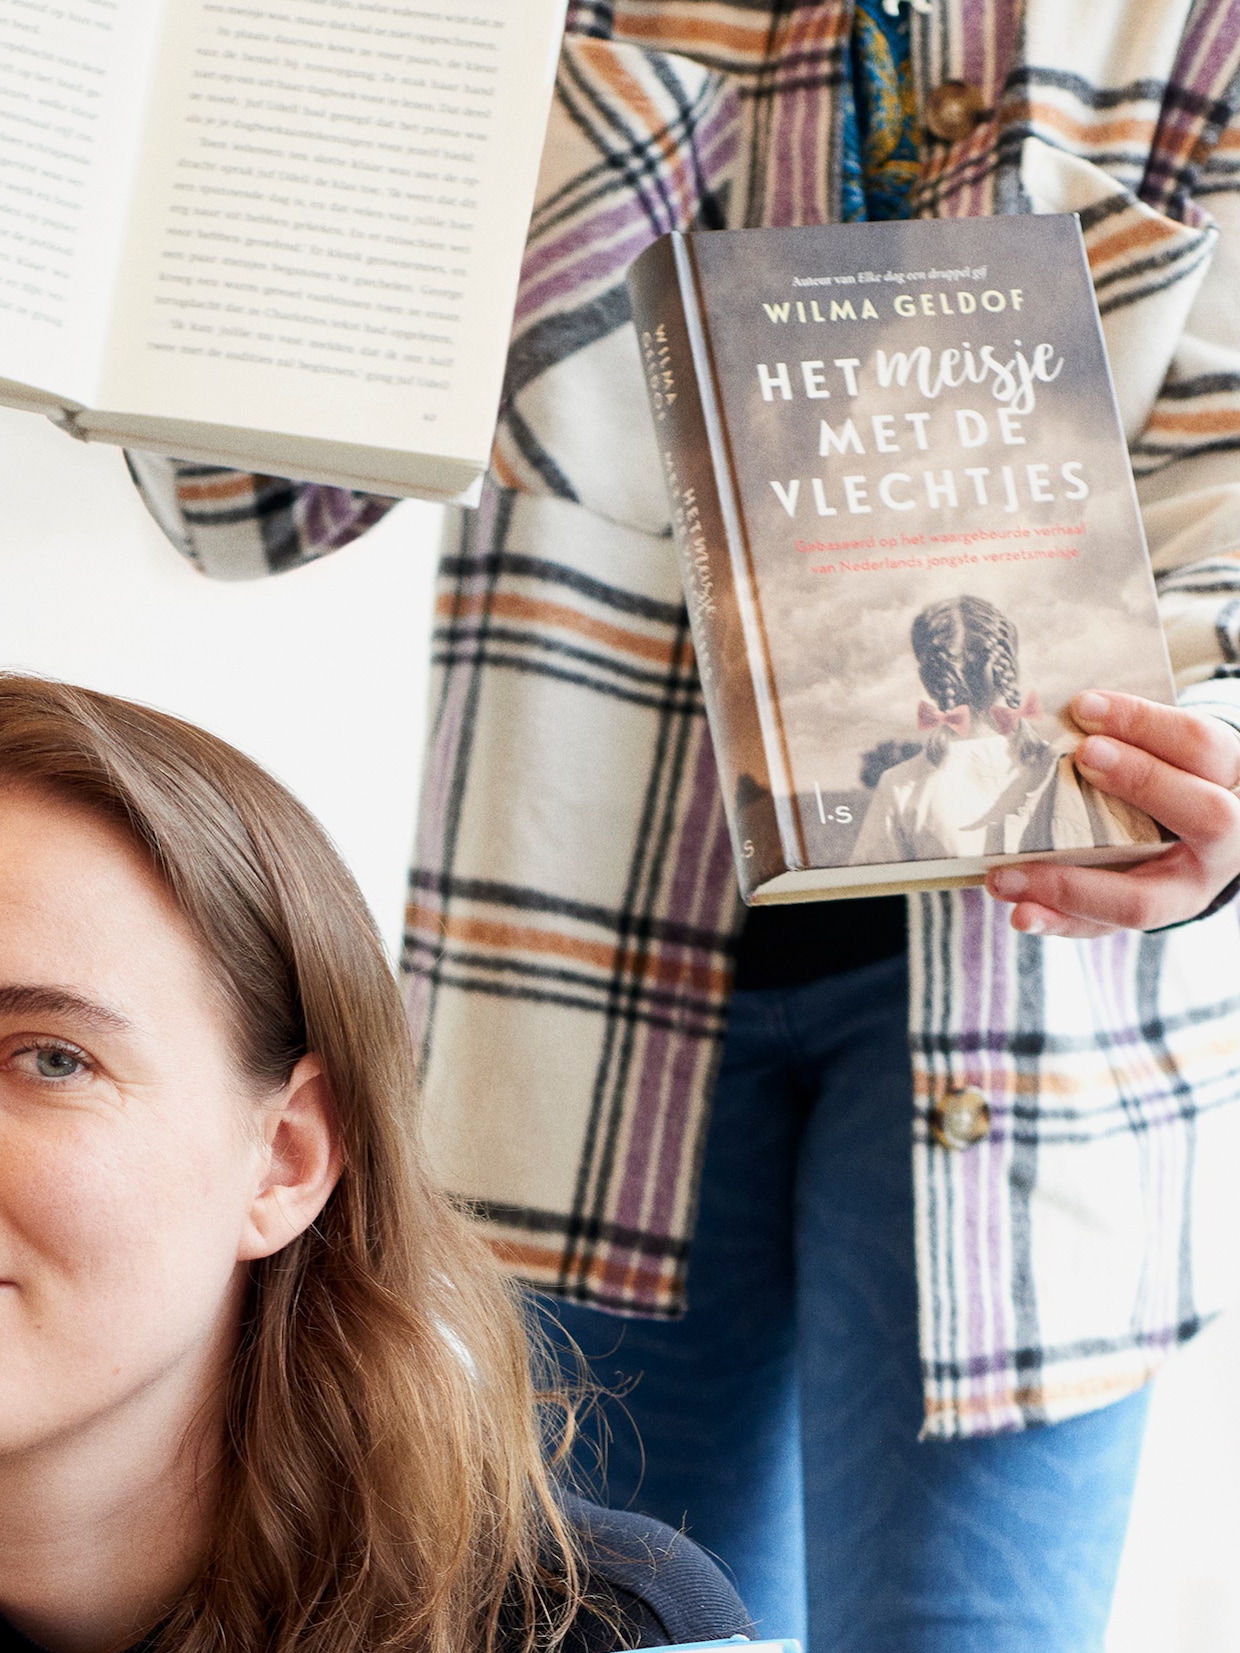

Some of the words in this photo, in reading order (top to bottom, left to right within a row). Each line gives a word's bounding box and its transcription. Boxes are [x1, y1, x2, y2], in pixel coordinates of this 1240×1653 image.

[762, 298, 879, 325] WILMA
[894, 289, 1024, 318] GELDOF
[757, 358, 861, 402] HET
[876, 339, 1064, 415] meisje
[818, 412, 931, 457] MET
[955, 407, 1027, 448] DE
[769, 461, 1090, 518] VLECHTJES
[793, 534, 876, 554] Gebaseerd
[878, 535, 898, 549] op
[900, 531, 926, 546] het
[928, 526, 1031, 546] waargebeurde
[1033, 523, 1086, 538] verhaal
[809, 564, 835, 576] van
[838, 555, 922, 574] Nederlands
[925, 552, 979, 570] jongste
[982, 546, 1079, 566] verzetsmeisje
